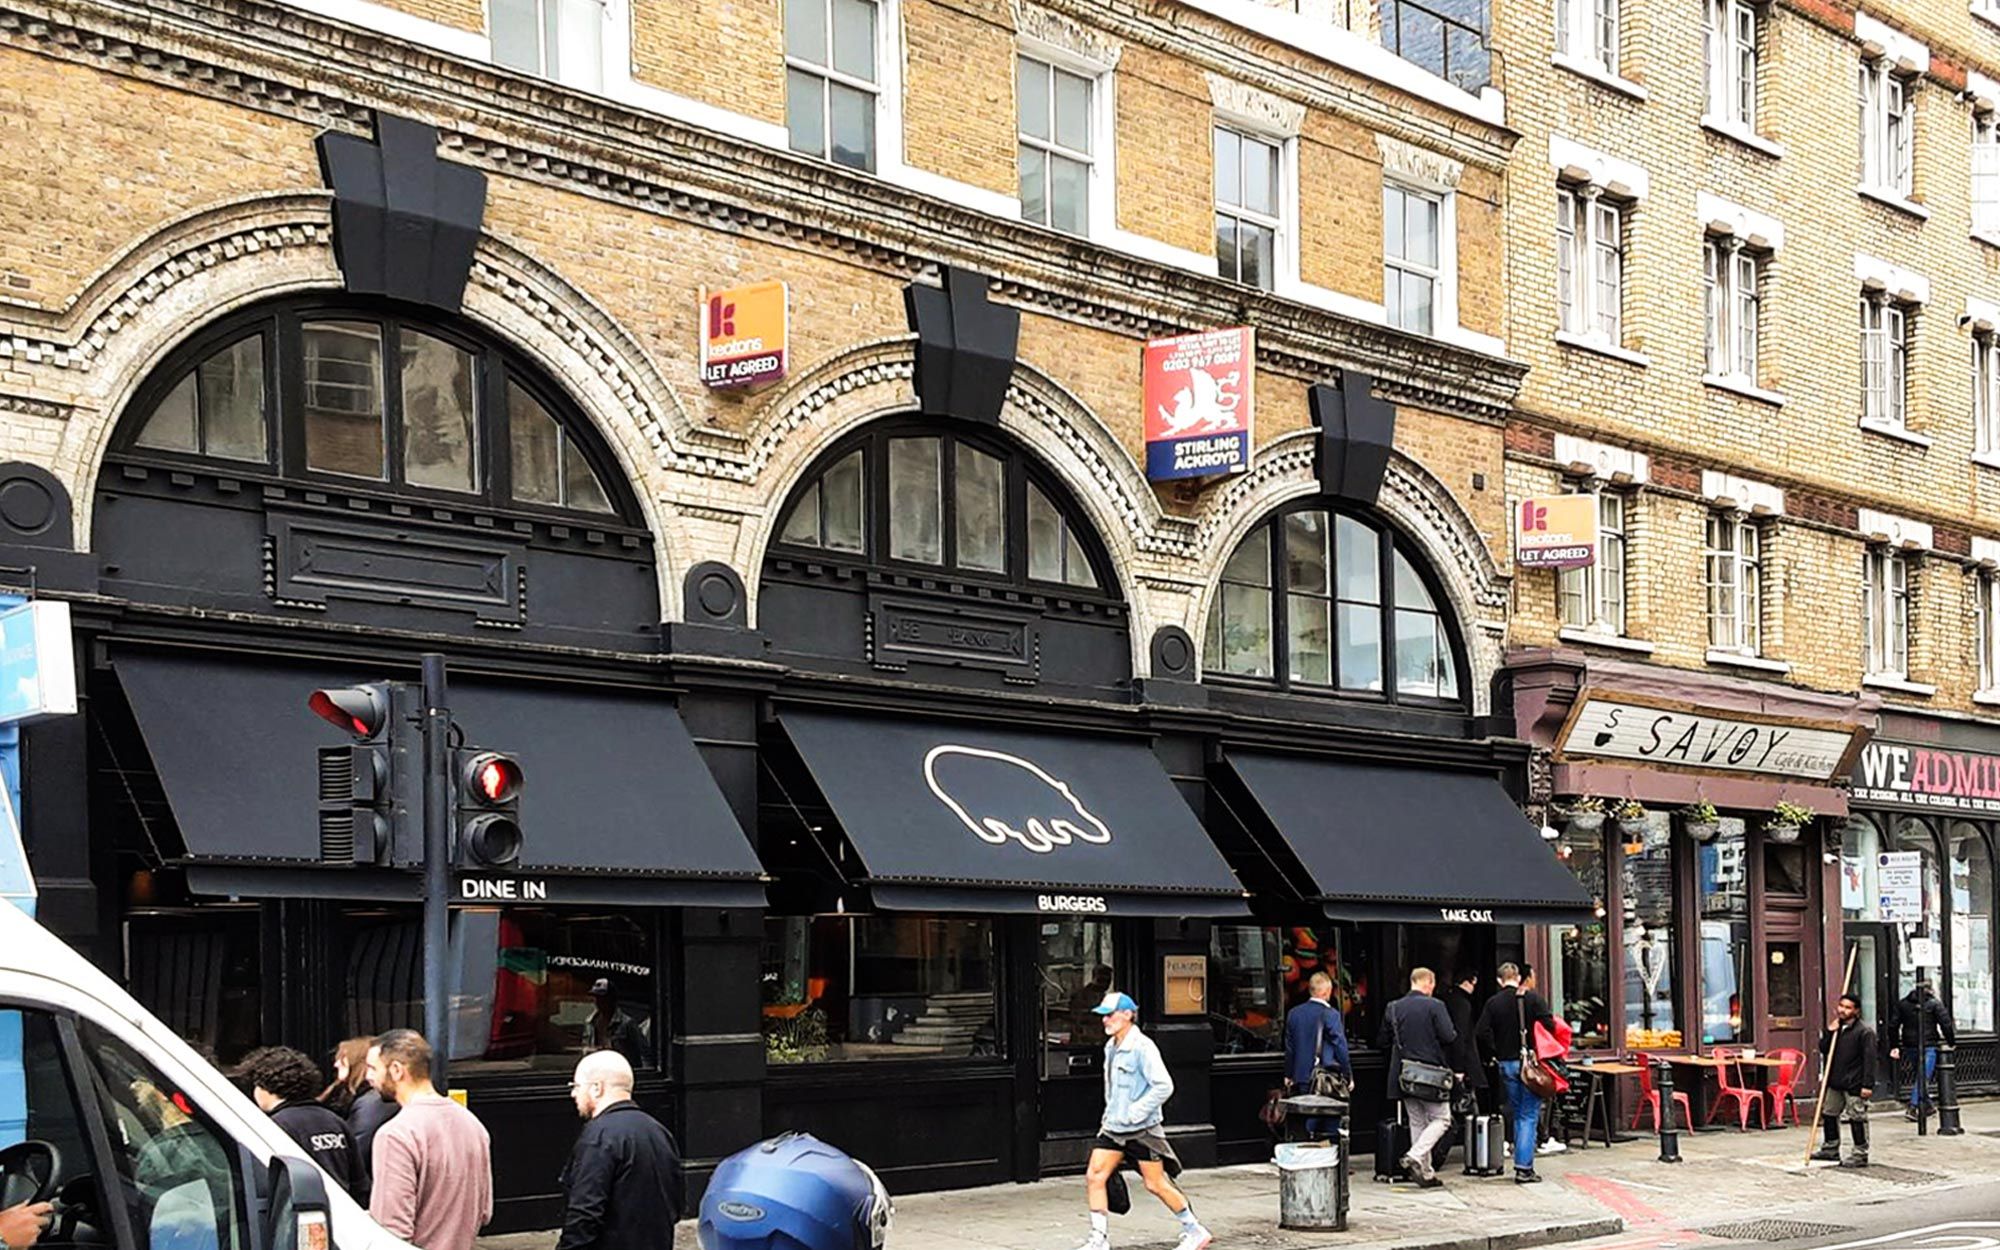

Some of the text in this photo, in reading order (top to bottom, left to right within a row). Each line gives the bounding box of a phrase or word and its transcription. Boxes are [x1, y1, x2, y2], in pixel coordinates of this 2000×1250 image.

[708, 356, 778, 380] LET AGREED
[1174, 436, 1240, 456] STIRLING
[1174, 450, 1240, 471] ACKROYD
[1521, 548, 1589, 561] LET AGREED
[1638, 716, 1790, 768] SAVOY
[462, 879, 546, 899] DINE IN
[1038, 895, 1107, 912] BURGERS
[1440, 909, 1493, 922] TAKE OUT
